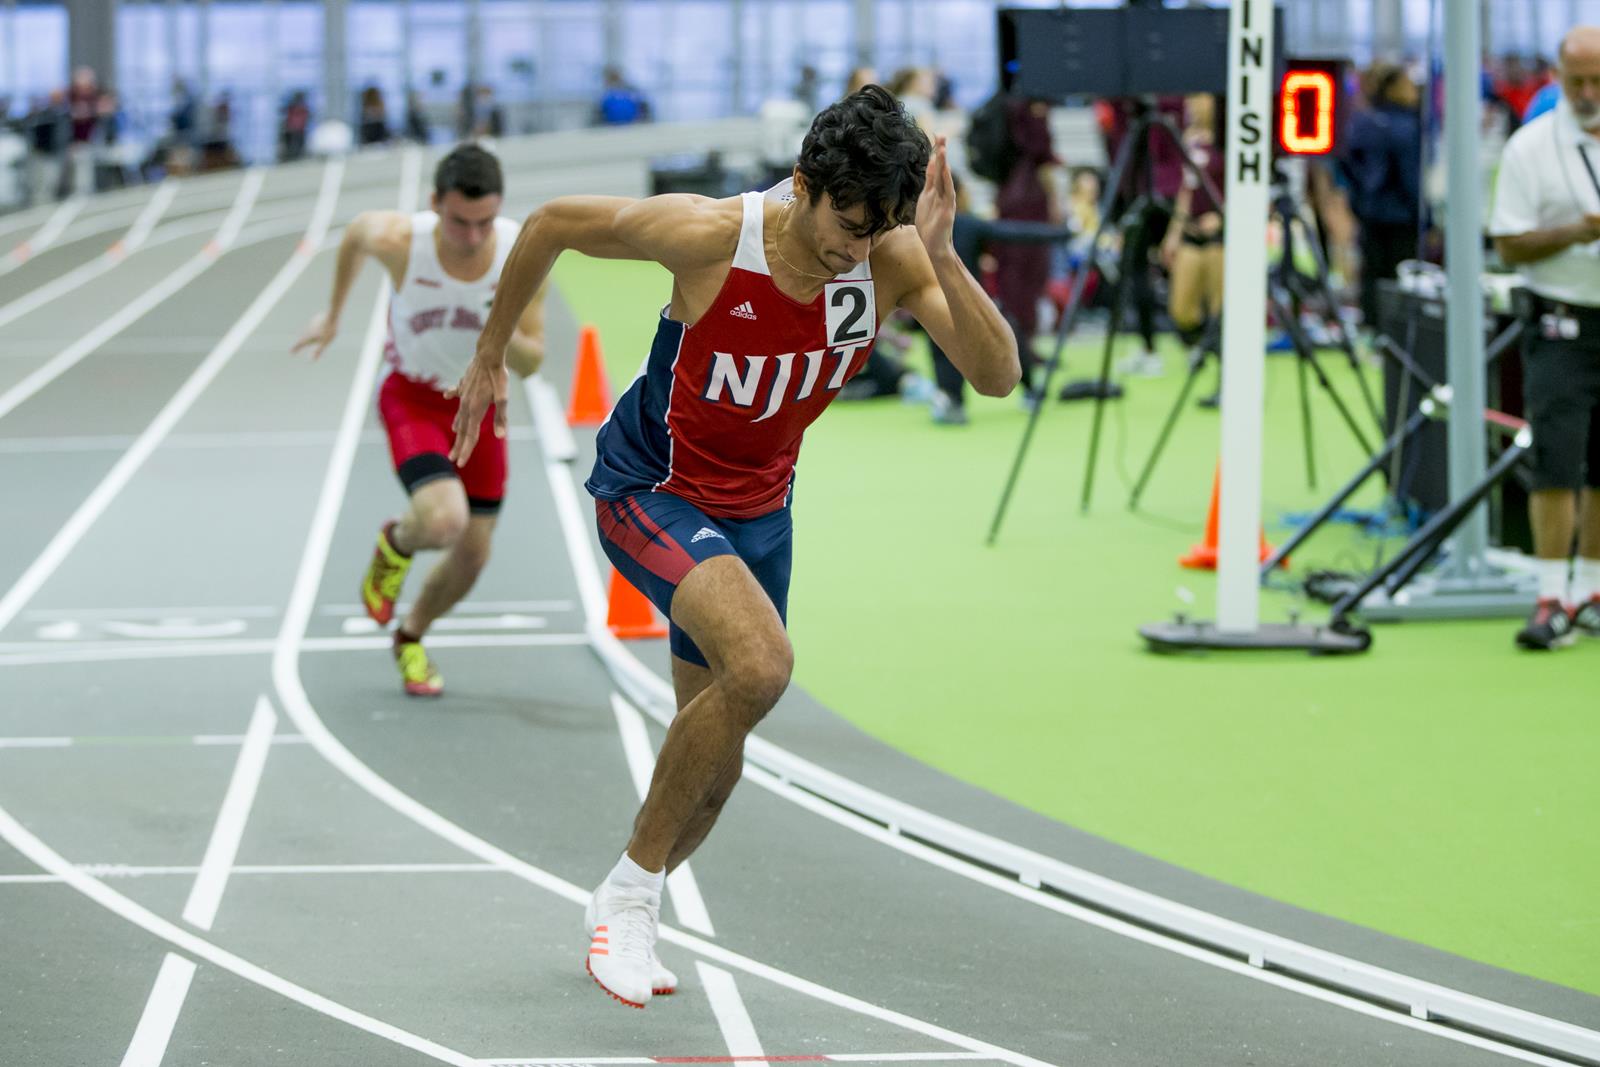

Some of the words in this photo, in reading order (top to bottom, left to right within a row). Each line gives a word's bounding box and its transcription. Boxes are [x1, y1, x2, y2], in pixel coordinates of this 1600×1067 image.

[1281, 70, 1335, 154] 0
[729, 309, 758, 321] adidas
[831, 286, 867, 343] 2
[702, 341, 871, 422] NJIT
